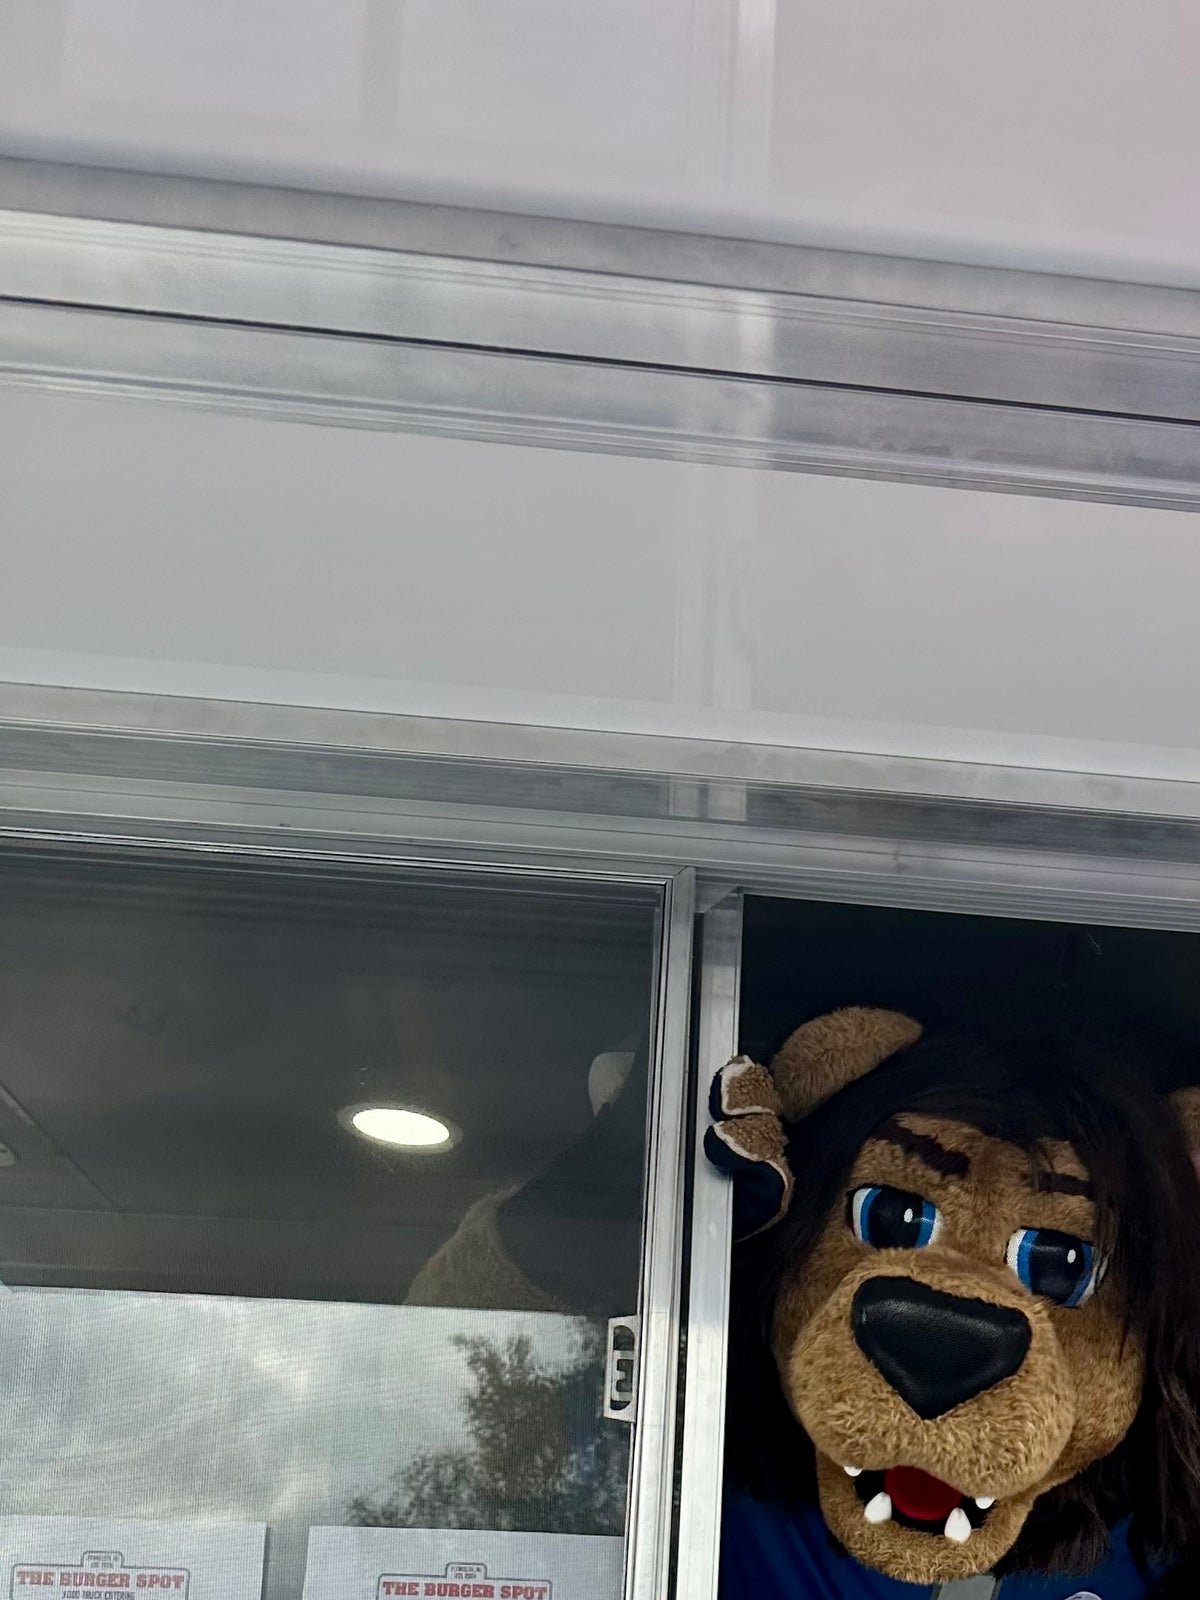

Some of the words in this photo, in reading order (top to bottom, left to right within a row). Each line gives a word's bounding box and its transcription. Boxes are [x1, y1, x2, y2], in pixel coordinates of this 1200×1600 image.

[16, 1571, 55, 1586] THE
[59, 1571, 131, 1588] BURGER
[136, 1573, 185, 1589] SPOT
[383, 1581, 419, 1596] THE
[424, 1582, 495, 1599] BURGER
[500, 1585, 547, 1600] SPOT
